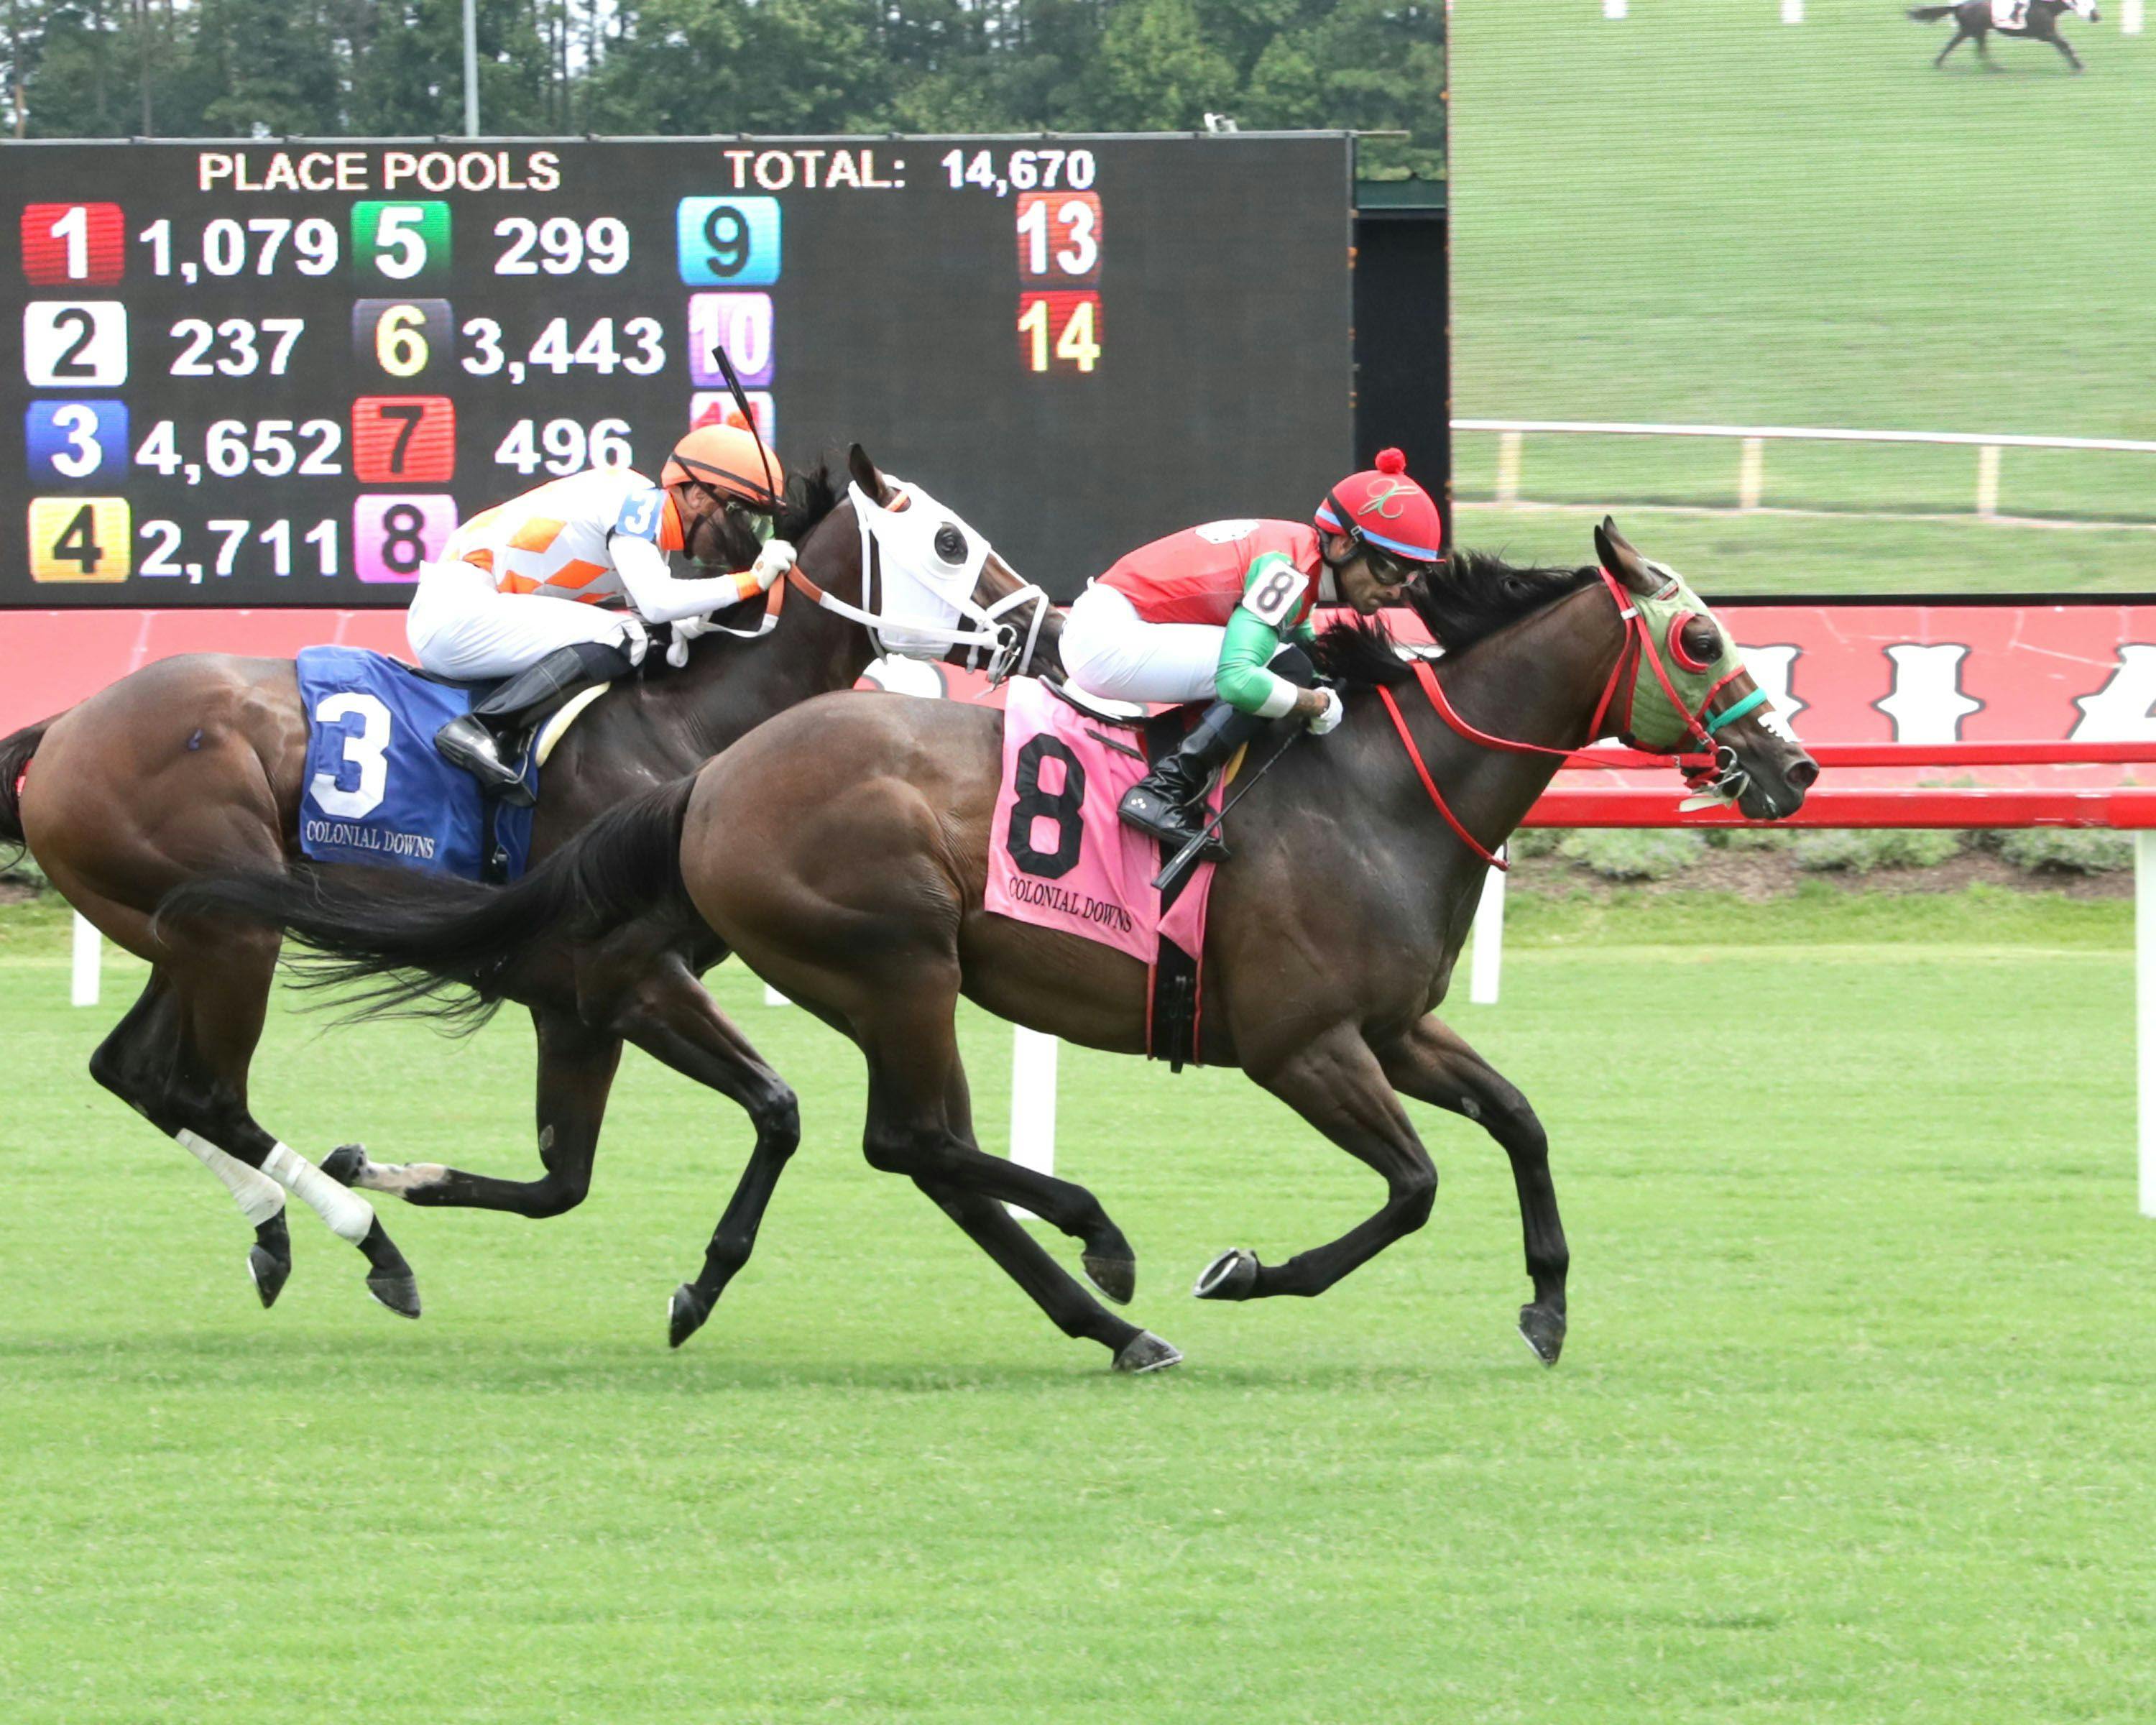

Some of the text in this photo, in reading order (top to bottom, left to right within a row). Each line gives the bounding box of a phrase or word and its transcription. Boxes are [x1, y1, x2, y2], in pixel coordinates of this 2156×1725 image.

[199, 151, 561, 192] PLACE POOLS
[723, 149, 1096, 197] TOTAL: 14,670
[50, 206, 339, 284] 1 1,079
[374, 206, 630, 280] 5 299
[704, 206, 750, 277] 9
[1017, 199, 1098, 275] 13
[52, 308, 305, 377] 2 237
[376, 304, 666, 385] 6 3,443
[690, 302, 771, 376] 10
[1018, 299, 1102, 372] 14
[50, 403, 343, 485] 3 4,652
[380, 405, 633, 477] 7 496
[52, 504, 338, 584] 4 2,711
[382, 503, 427, 574] 8
[624, 492, 659, 534] 3
[1256, 571, 1294, 614] 8
[310, 692, 392, 819] 3
[306, 819, 436, 860] COLONIAL DOWNS
[1006, 732, 1086, 880] 8
[1009, 876, 1133, 933] COLONIAL DOWNS
